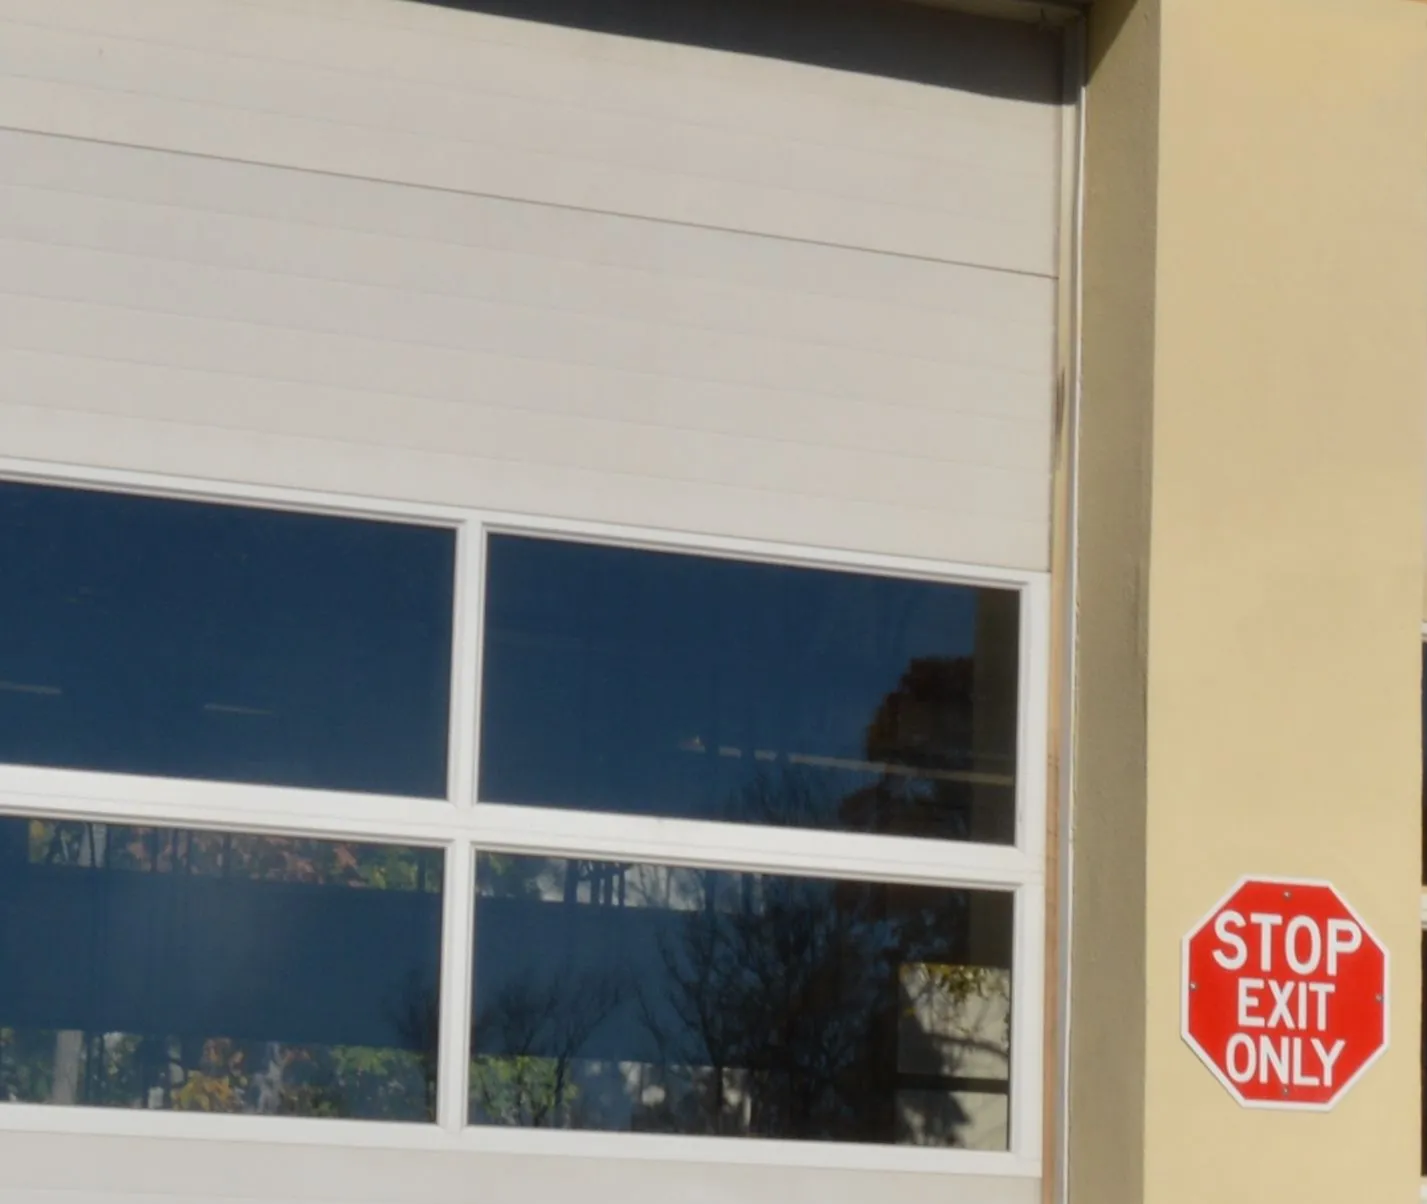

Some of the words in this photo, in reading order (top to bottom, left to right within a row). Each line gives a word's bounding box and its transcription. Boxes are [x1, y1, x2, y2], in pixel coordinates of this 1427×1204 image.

[1212, 909, 1362, 976] STOP
[1238, 977, 1335, 1031] EXIT
[1226, 1032, 1345, 1087] ONLY
